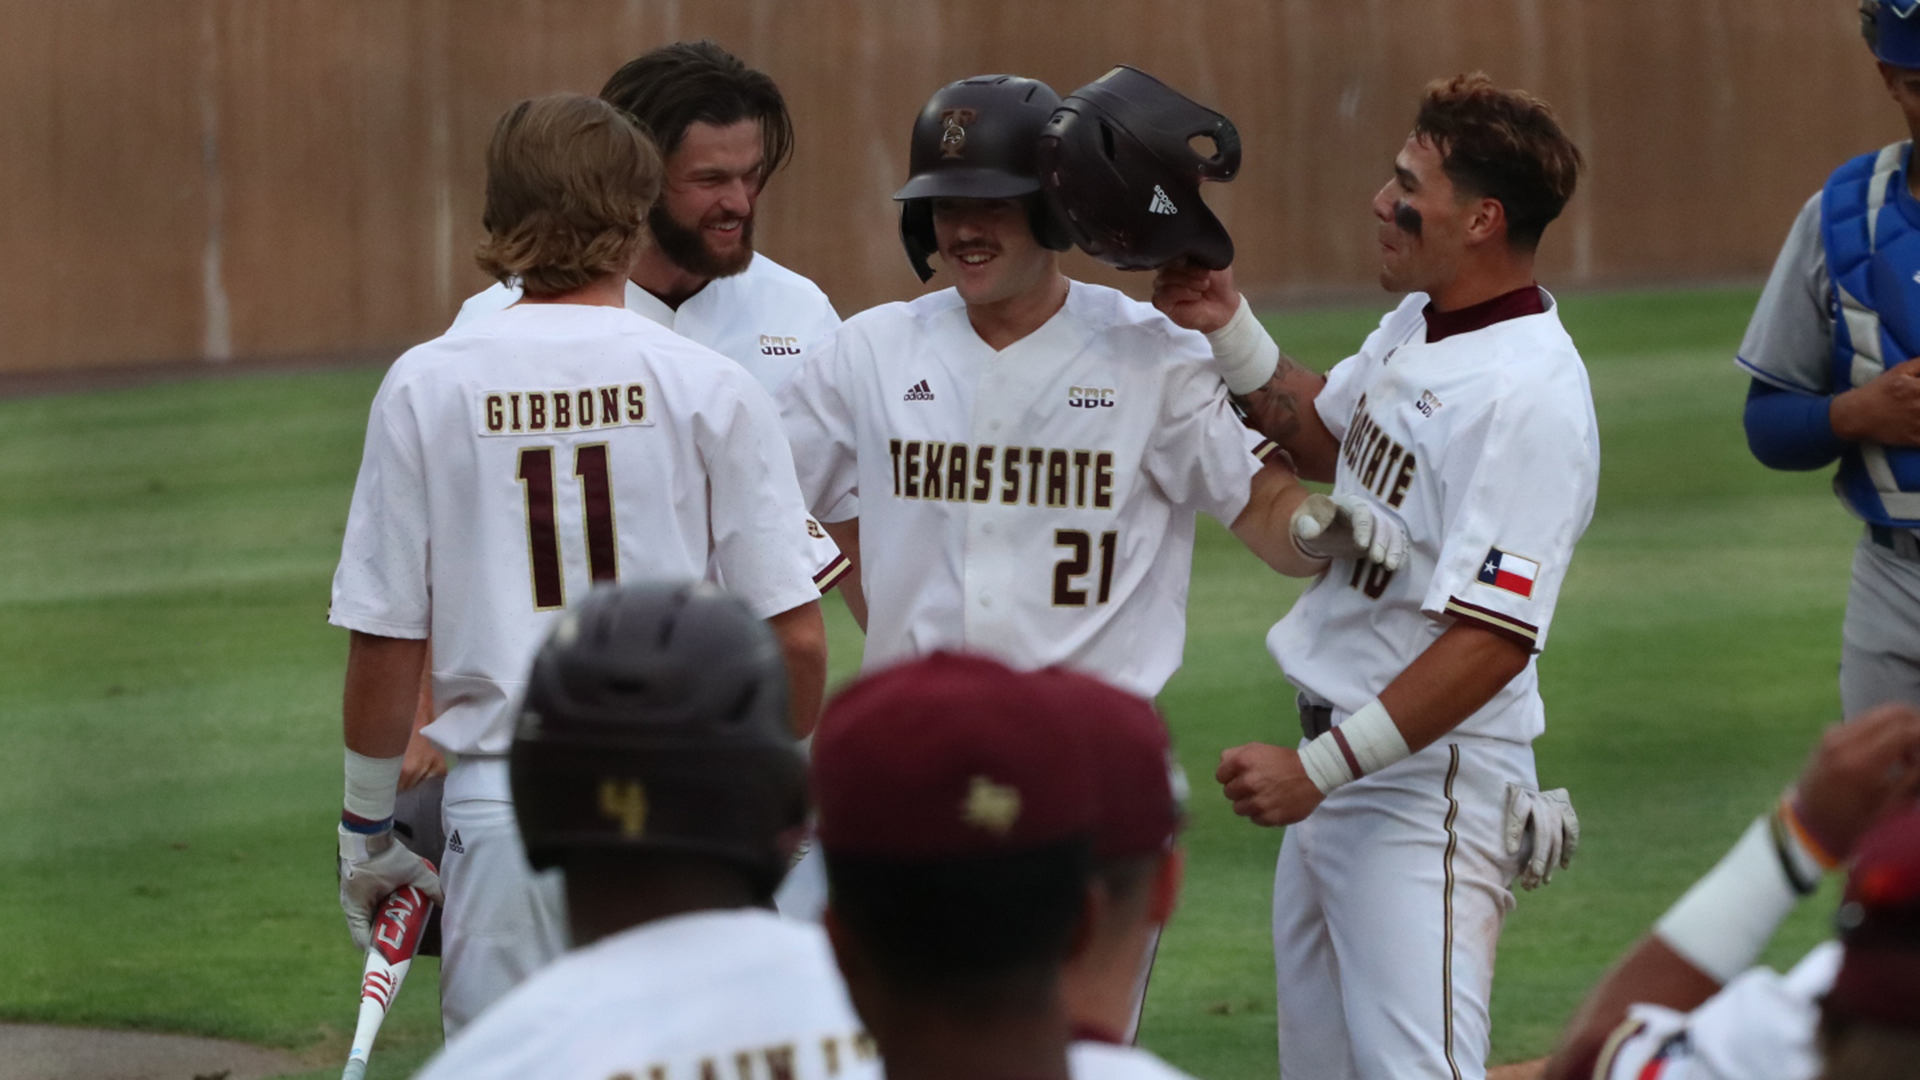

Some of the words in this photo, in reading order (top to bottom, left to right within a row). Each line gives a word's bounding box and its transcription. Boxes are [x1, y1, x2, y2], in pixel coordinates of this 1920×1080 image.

[485, 383, 646, 433] GIBBONS
[903, 391, 935, 401] adidas
[1068, 386, 1115, 408] SBC
[890, 438, 996, 504] TEXAS
[1000, 446, 1115, 509] STATE
[515, 440, 620, 612] 11
[1052, 528, 1118, 607] 21
